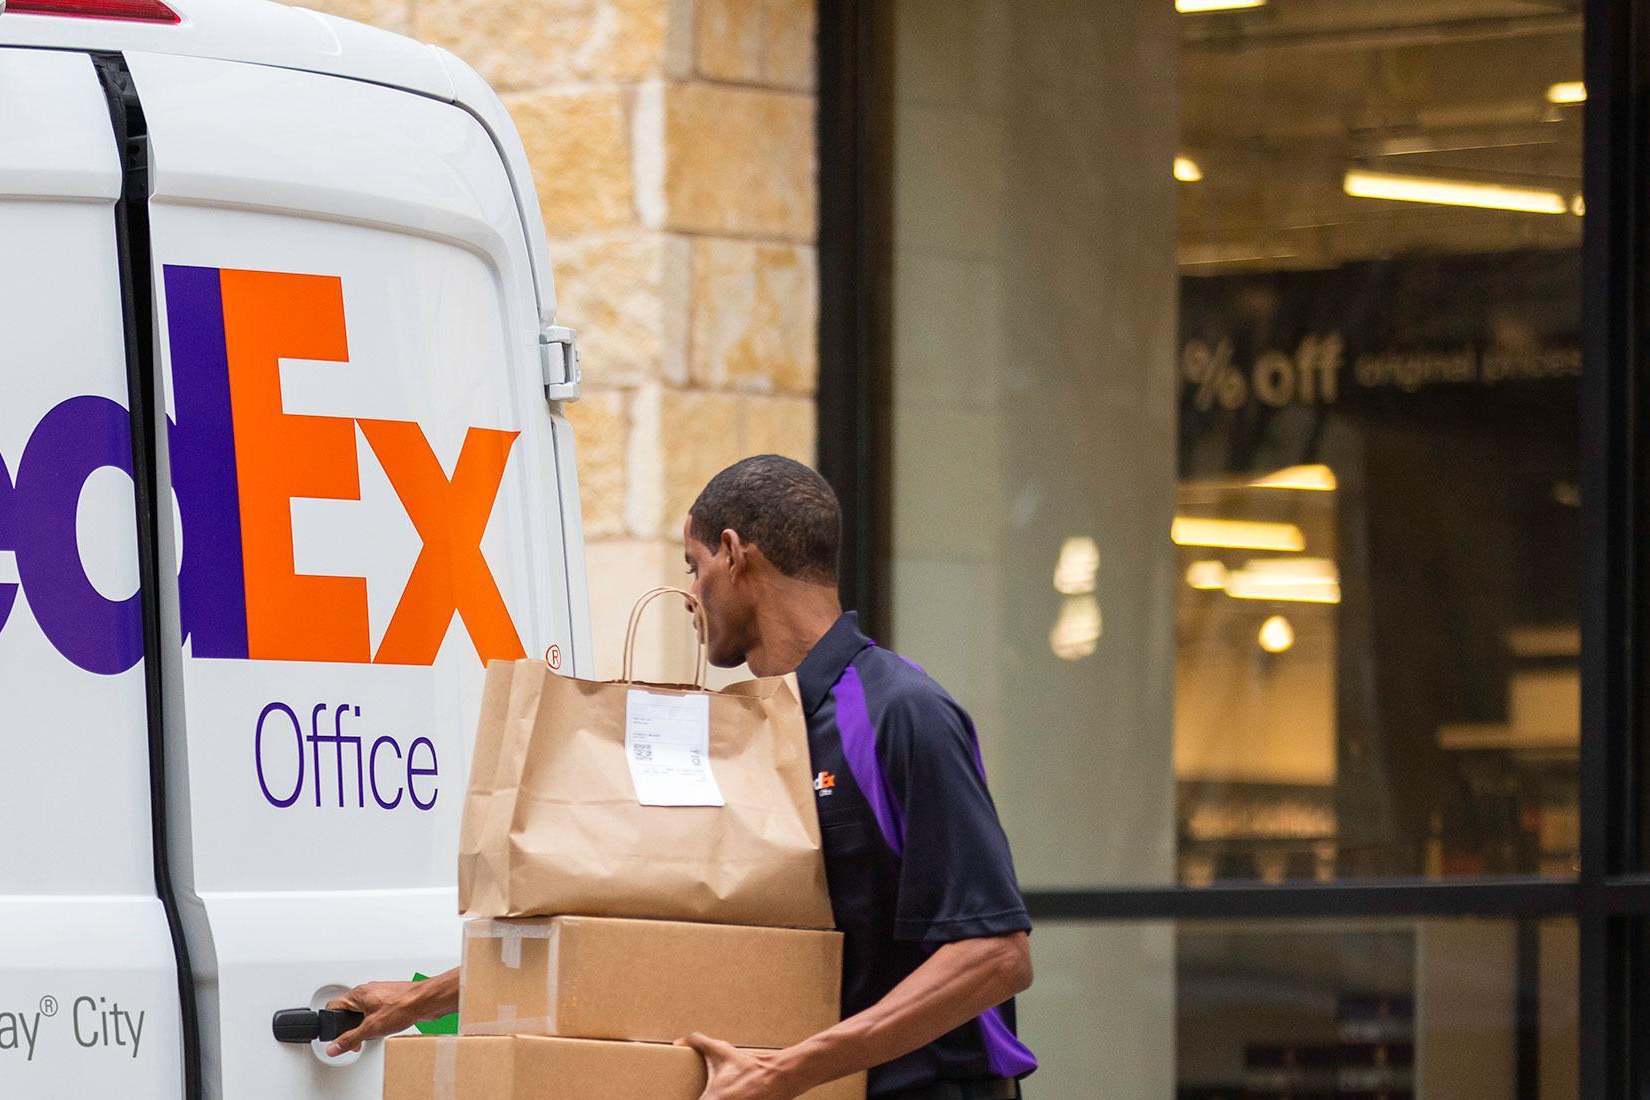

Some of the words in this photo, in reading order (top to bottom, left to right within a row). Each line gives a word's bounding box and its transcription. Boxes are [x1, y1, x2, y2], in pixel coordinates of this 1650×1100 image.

[1254, 332, 1346, 407] off
[254, 702, 439, 811] Office
[72, 996, 146, 1058] City
